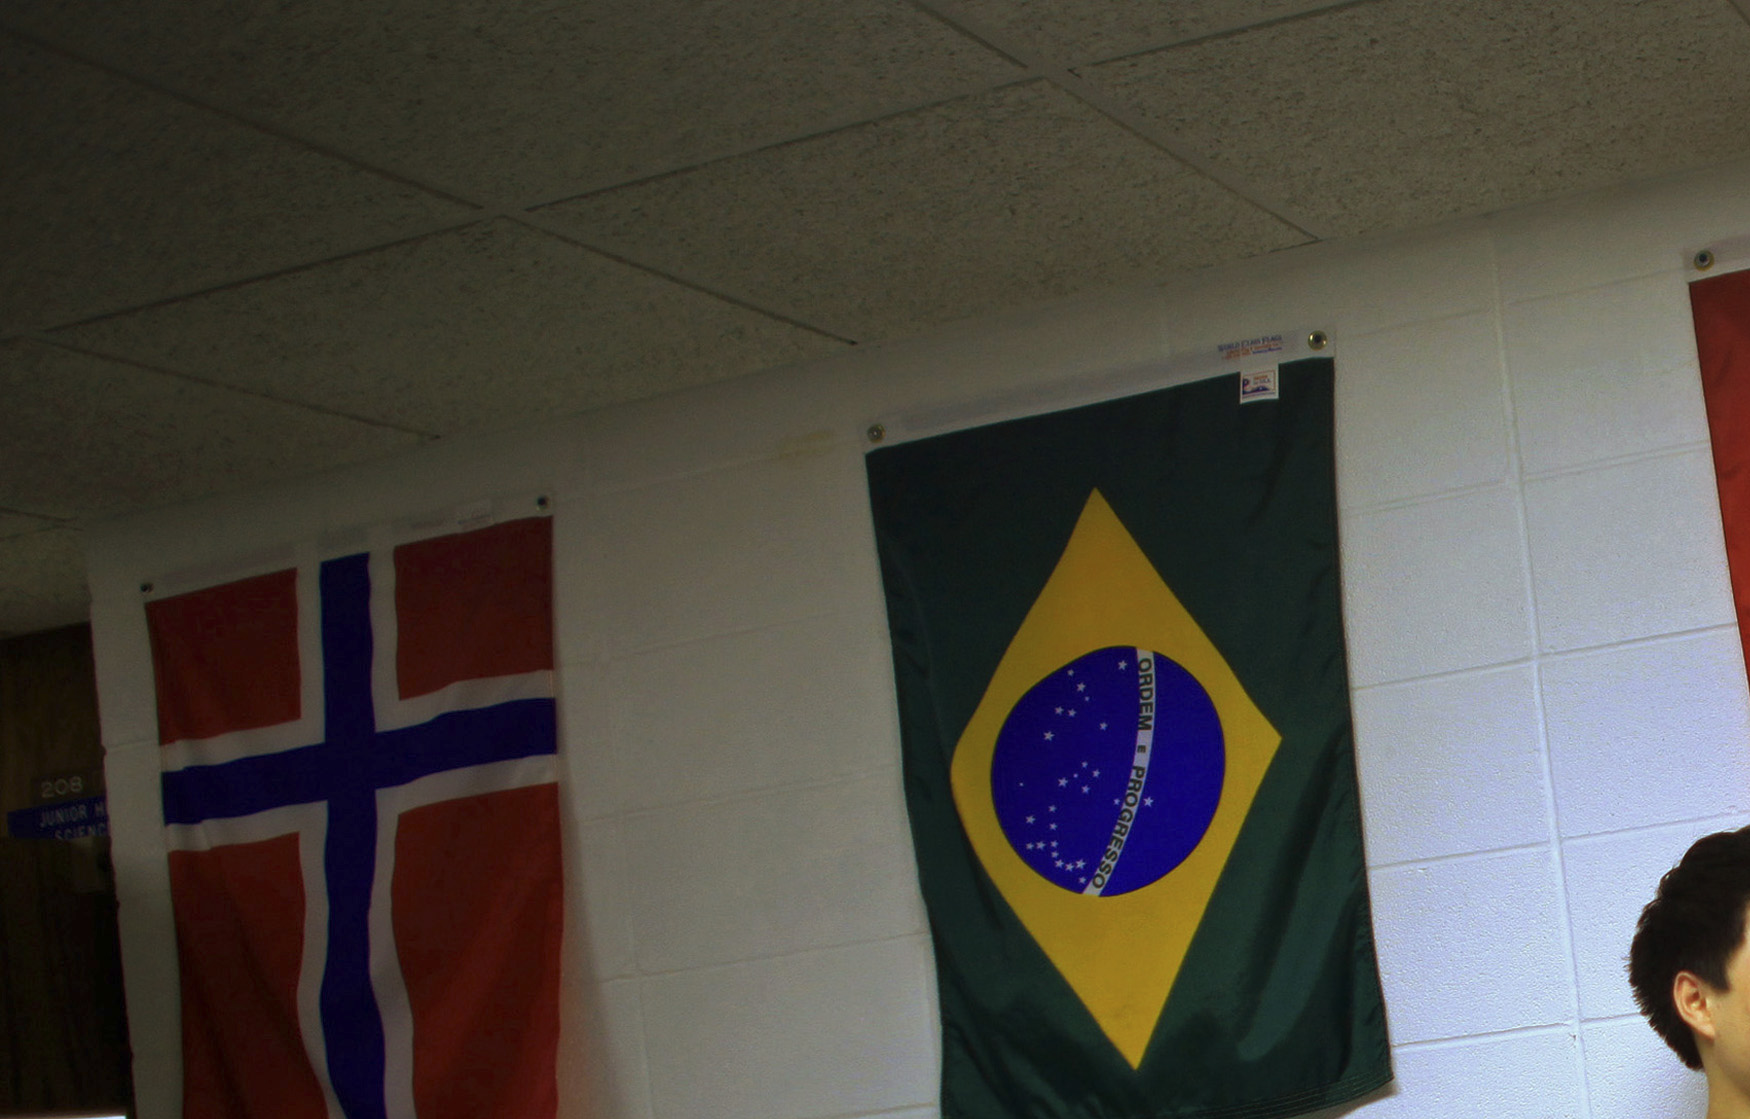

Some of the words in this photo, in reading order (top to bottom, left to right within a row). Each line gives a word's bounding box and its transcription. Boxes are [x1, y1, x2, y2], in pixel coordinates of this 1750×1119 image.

[1137, 657, 1154, 731] ORDEM
[41, 776, 83, 798] 208
[40, 804, 88, 828] JUNIOR
[1092, 765, 1146, 890] PROGRESSO
